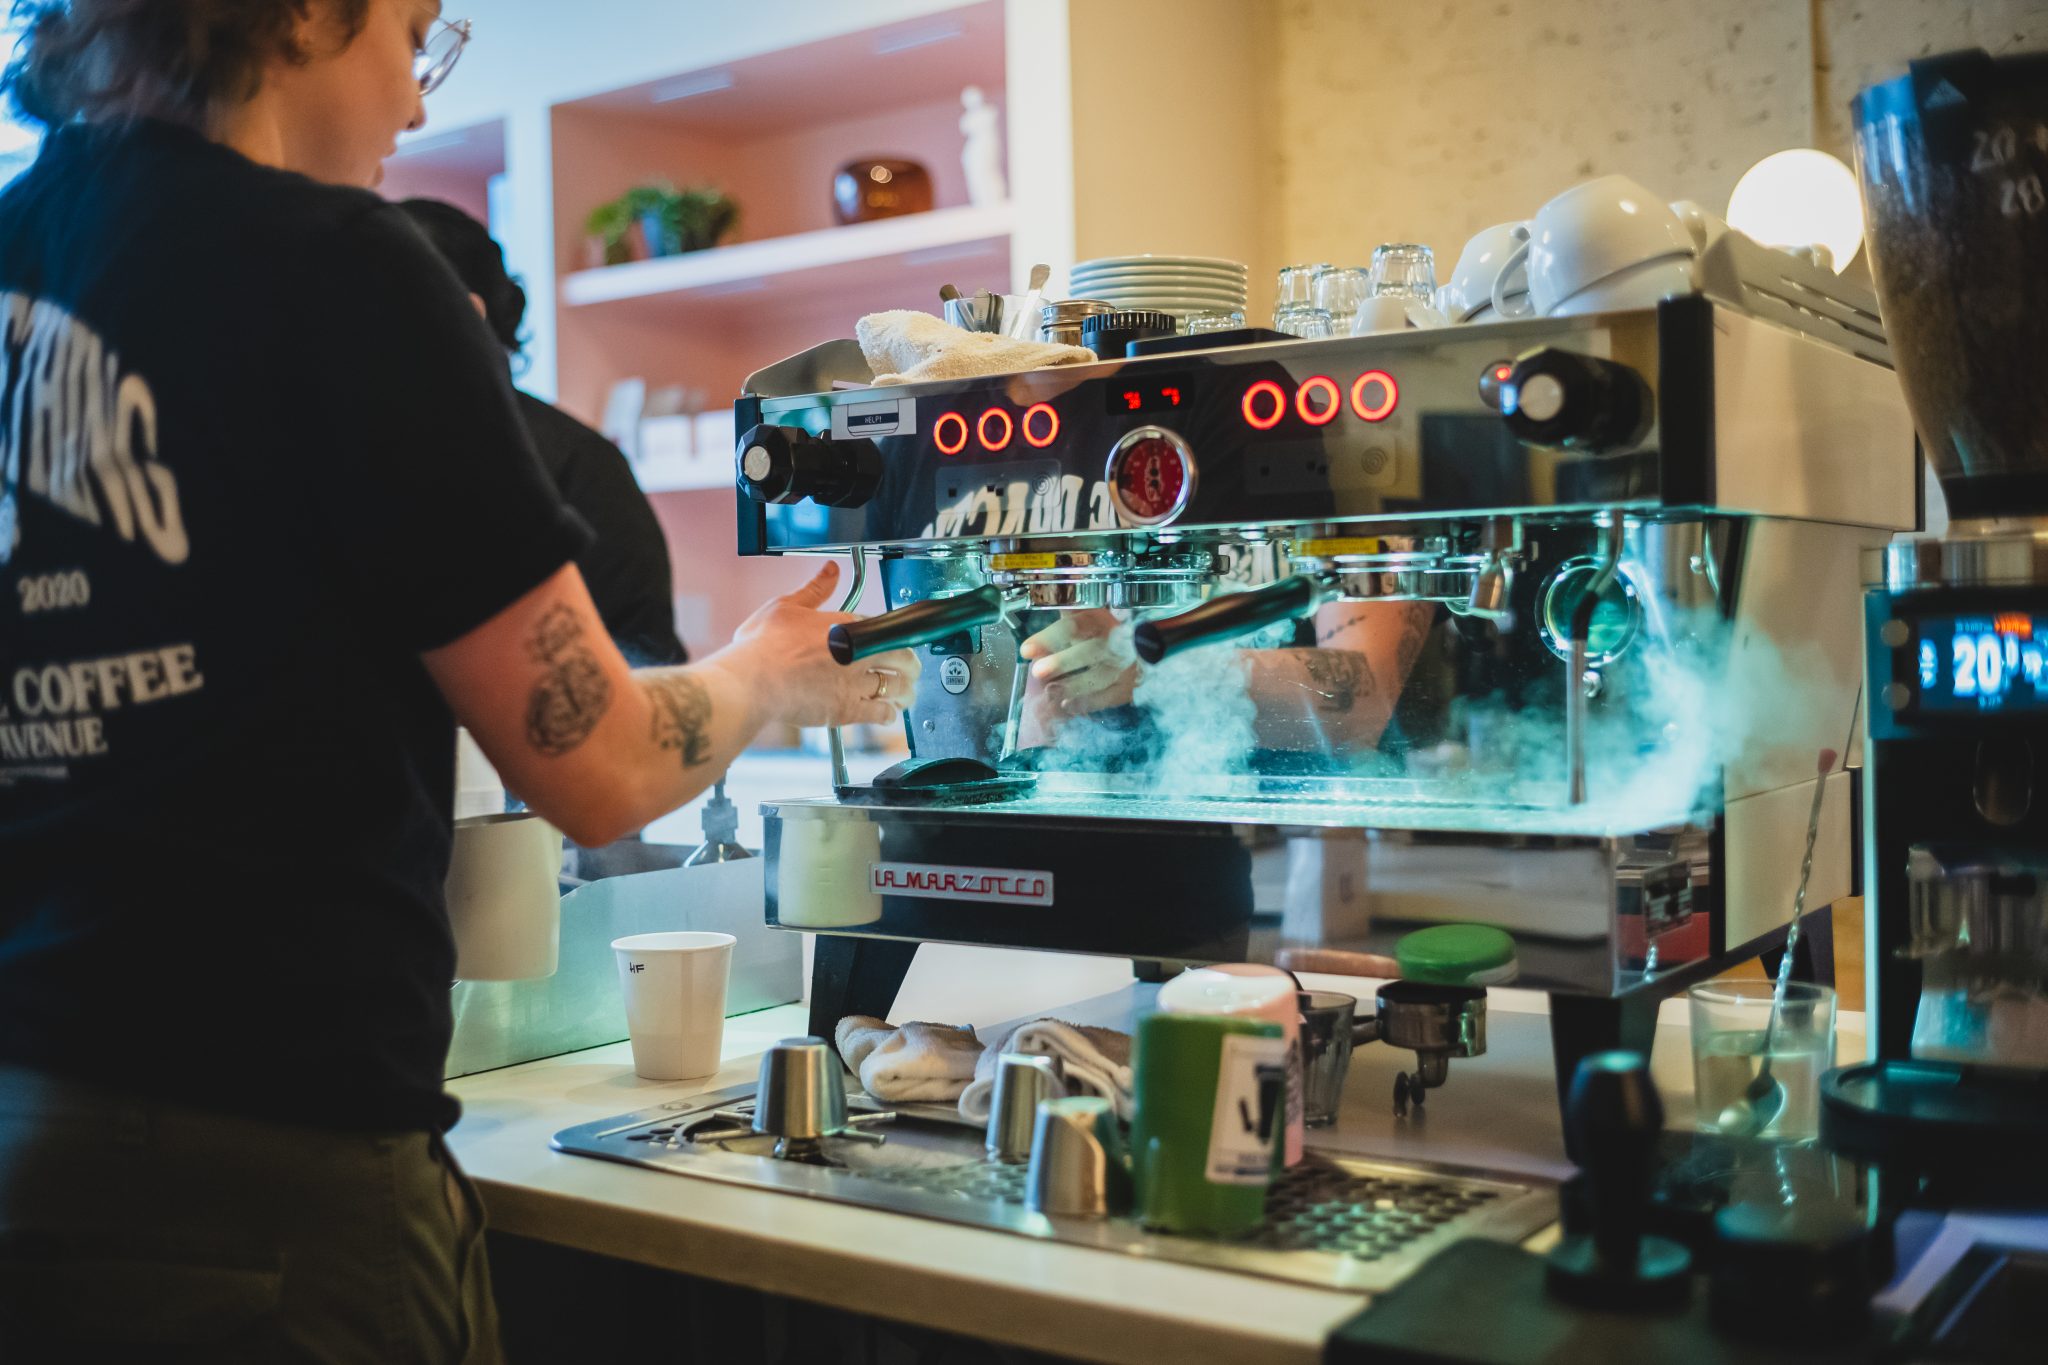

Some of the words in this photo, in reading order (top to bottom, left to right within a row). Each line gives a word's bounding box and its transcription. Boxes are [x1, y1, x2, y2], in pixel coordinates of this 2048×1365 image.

[864, 415, 882, 424] HELP!
[18, 570, 91, 613] 2020
[14, 644, 204, 717] COFFEE
[0, 716, 109, 760] AVENUE
[875, 869, 894, 887] LA
[906, 871, 1045, 897] MARZOCCO
[629, 962, 645, 974] HF
